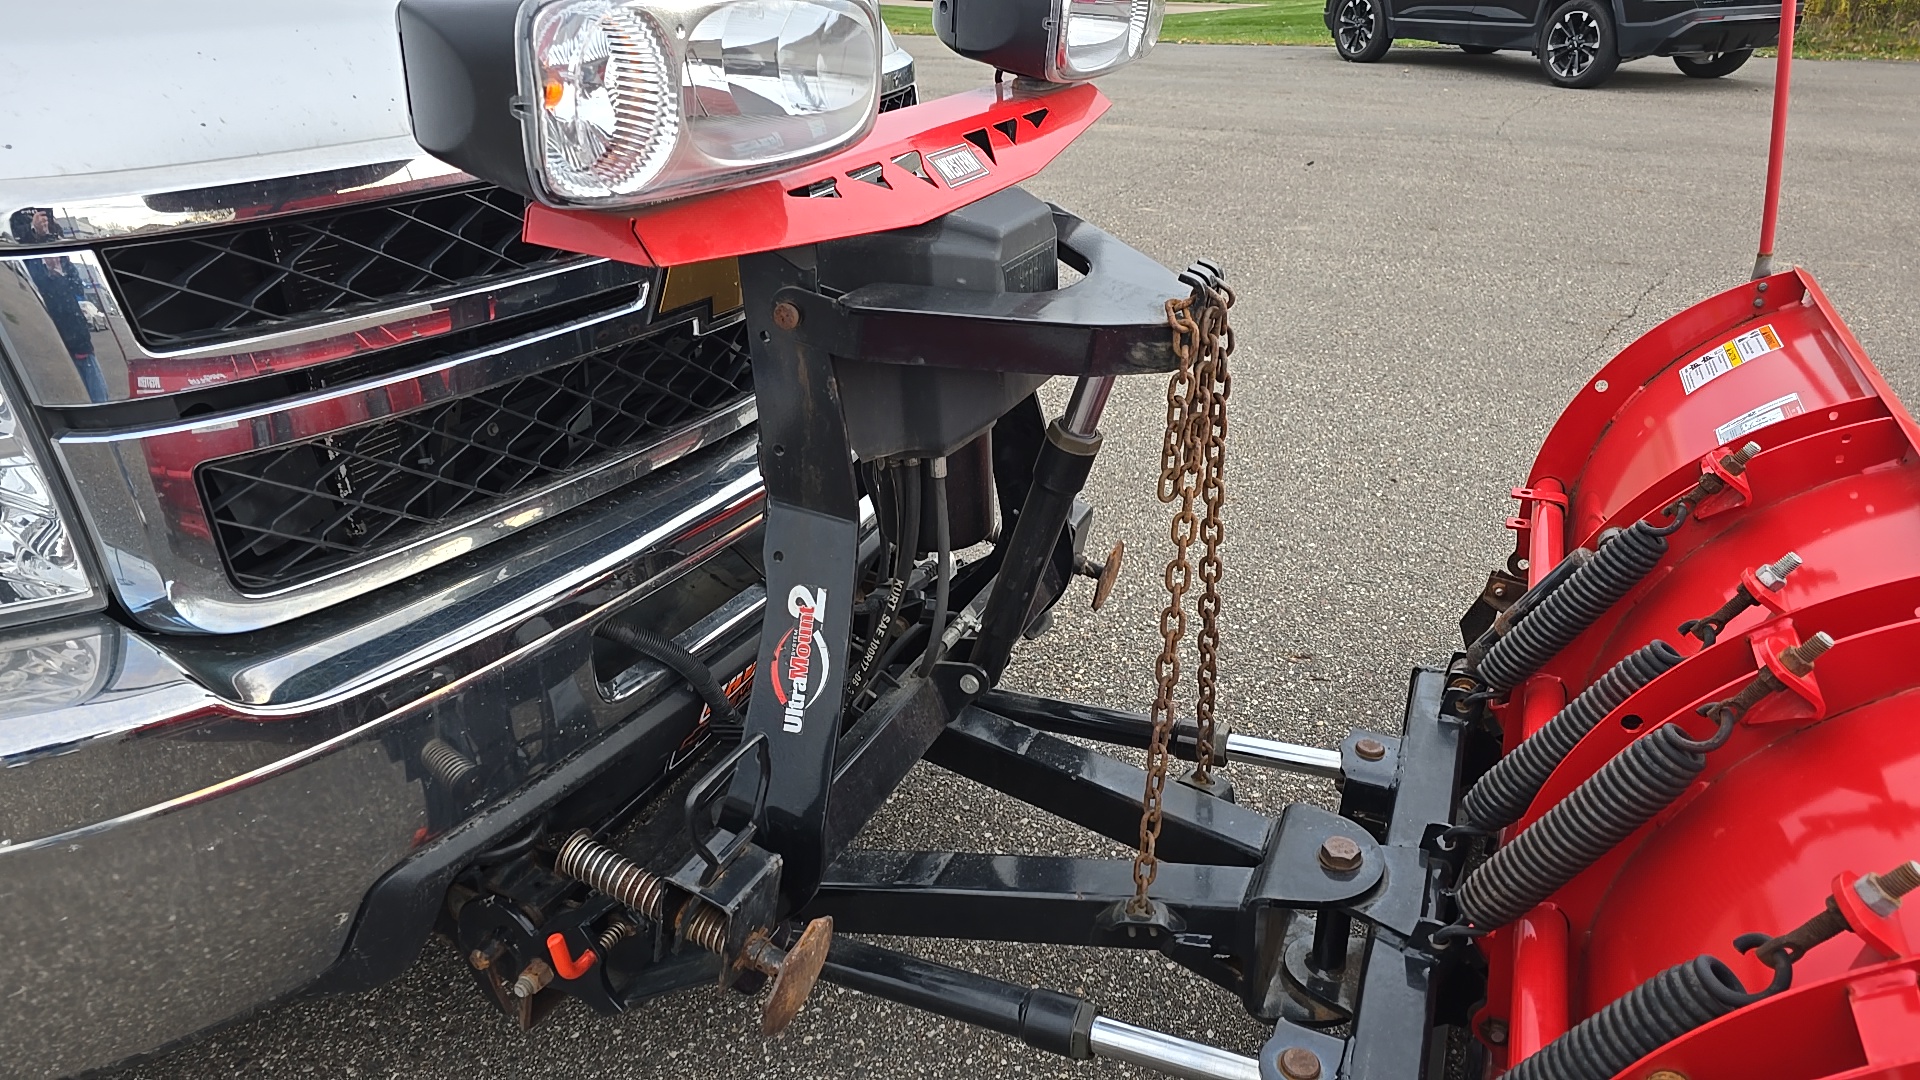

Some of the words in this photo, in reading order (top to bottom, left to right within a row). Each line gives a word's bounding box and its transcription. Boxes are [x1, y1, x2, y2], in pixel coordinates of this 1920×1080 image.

[934, 150, 981, 180] WESTERN
[788, 584, 828, 624] 2
[887, 577, 905, 612] KURT
[875, 613, 892, 638] SAE
[861, 638, 882, 672] 100R17
